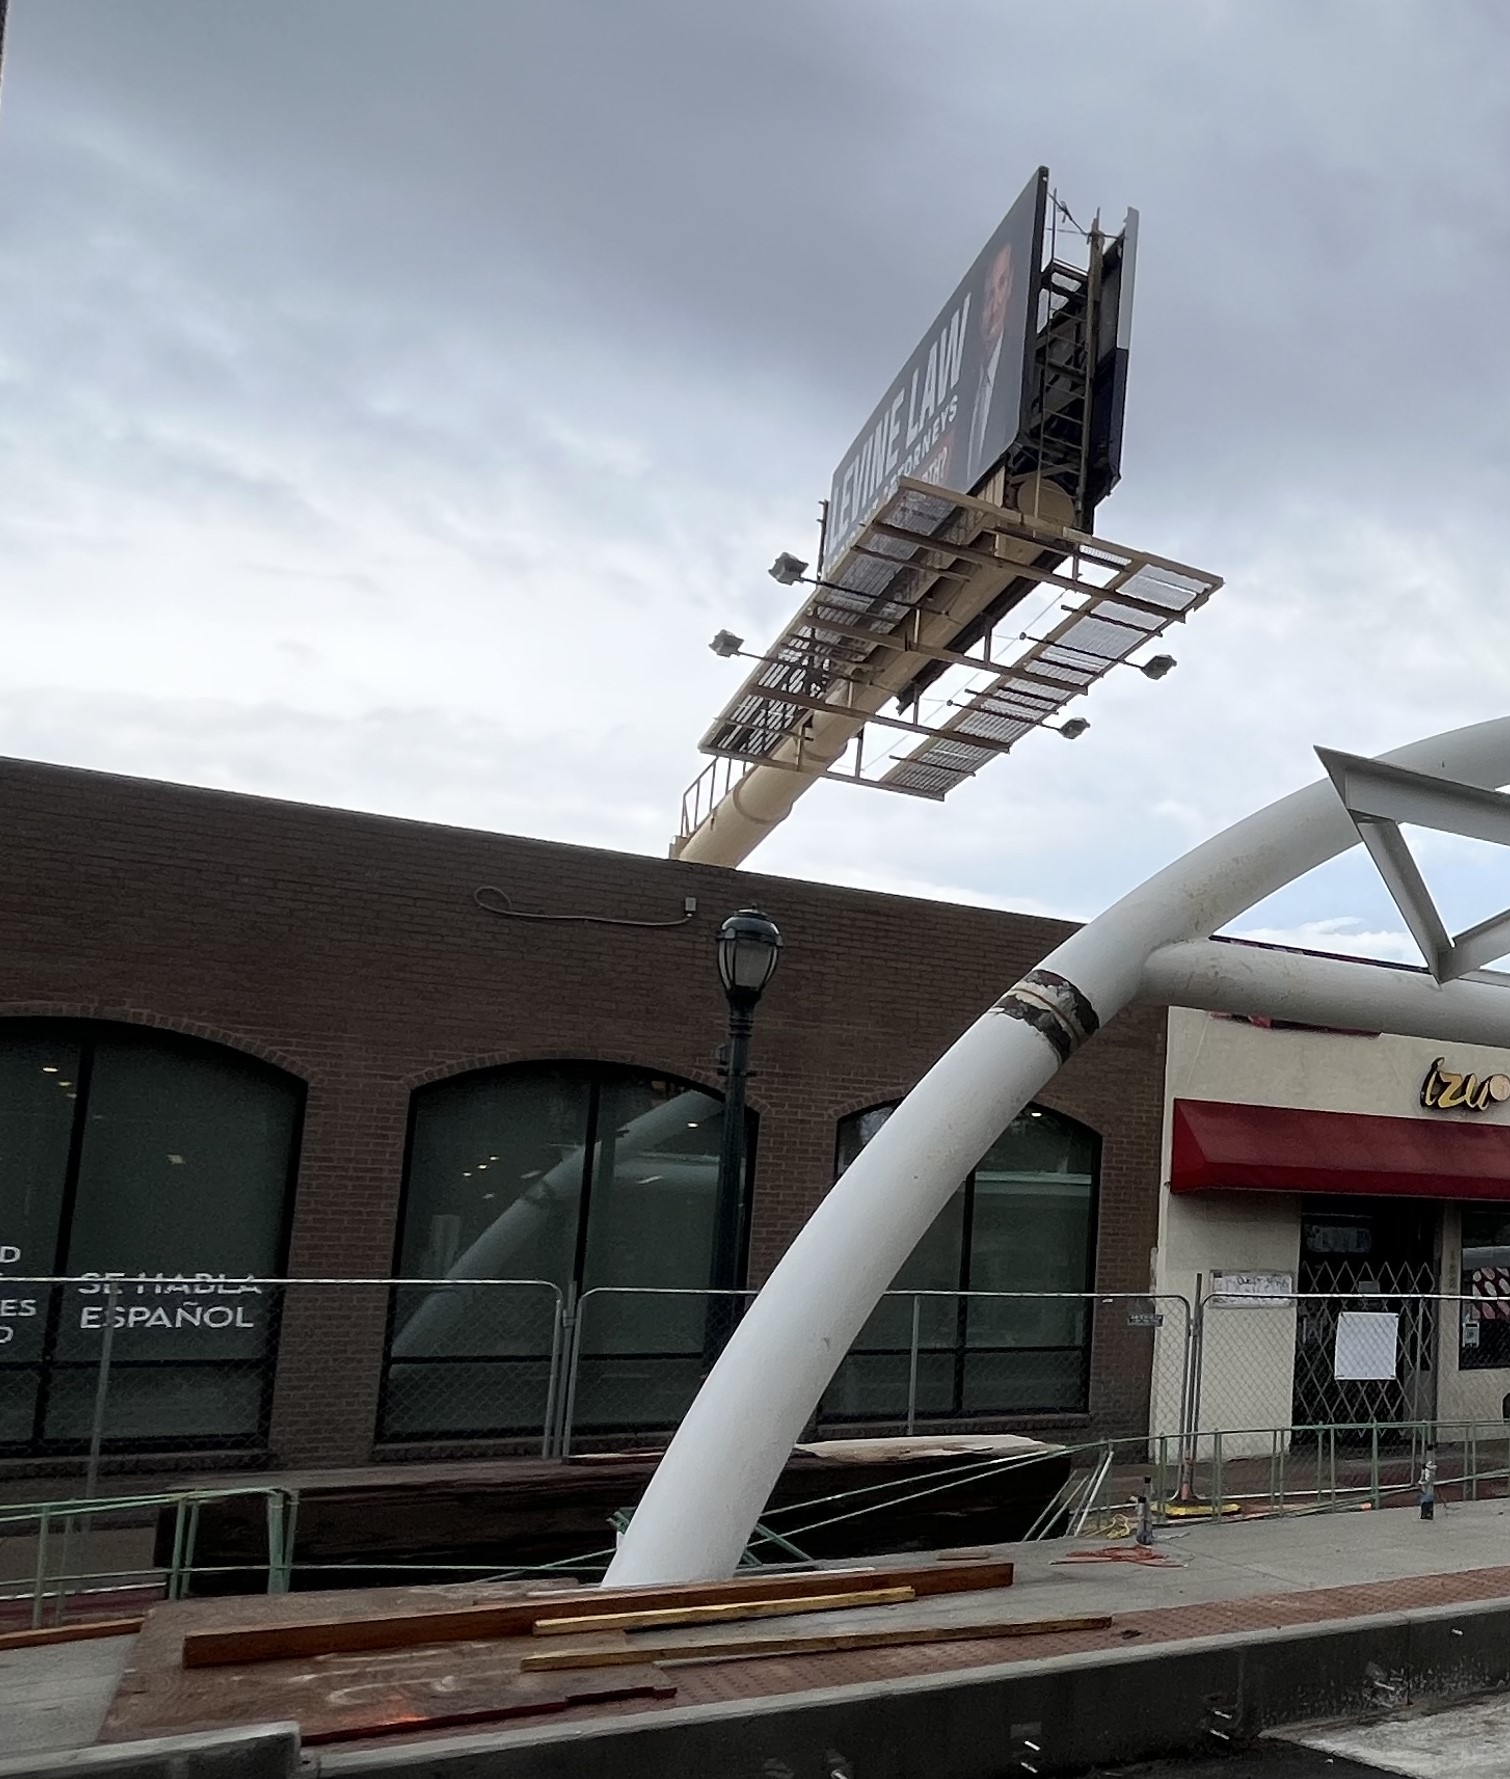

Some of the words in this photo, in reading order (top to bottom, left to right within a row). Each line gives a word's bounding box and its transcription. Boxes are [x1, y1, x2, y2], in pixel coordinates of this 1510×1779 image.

[829, 387, 905, 556] LEVINE
[905, 291, 971, 450] LAW
[78, 1272, 125, 1295] SE
[136, 1272, 262, 1296] HABLA
[80, 1301, 254, 1329] ESPAÑOL
